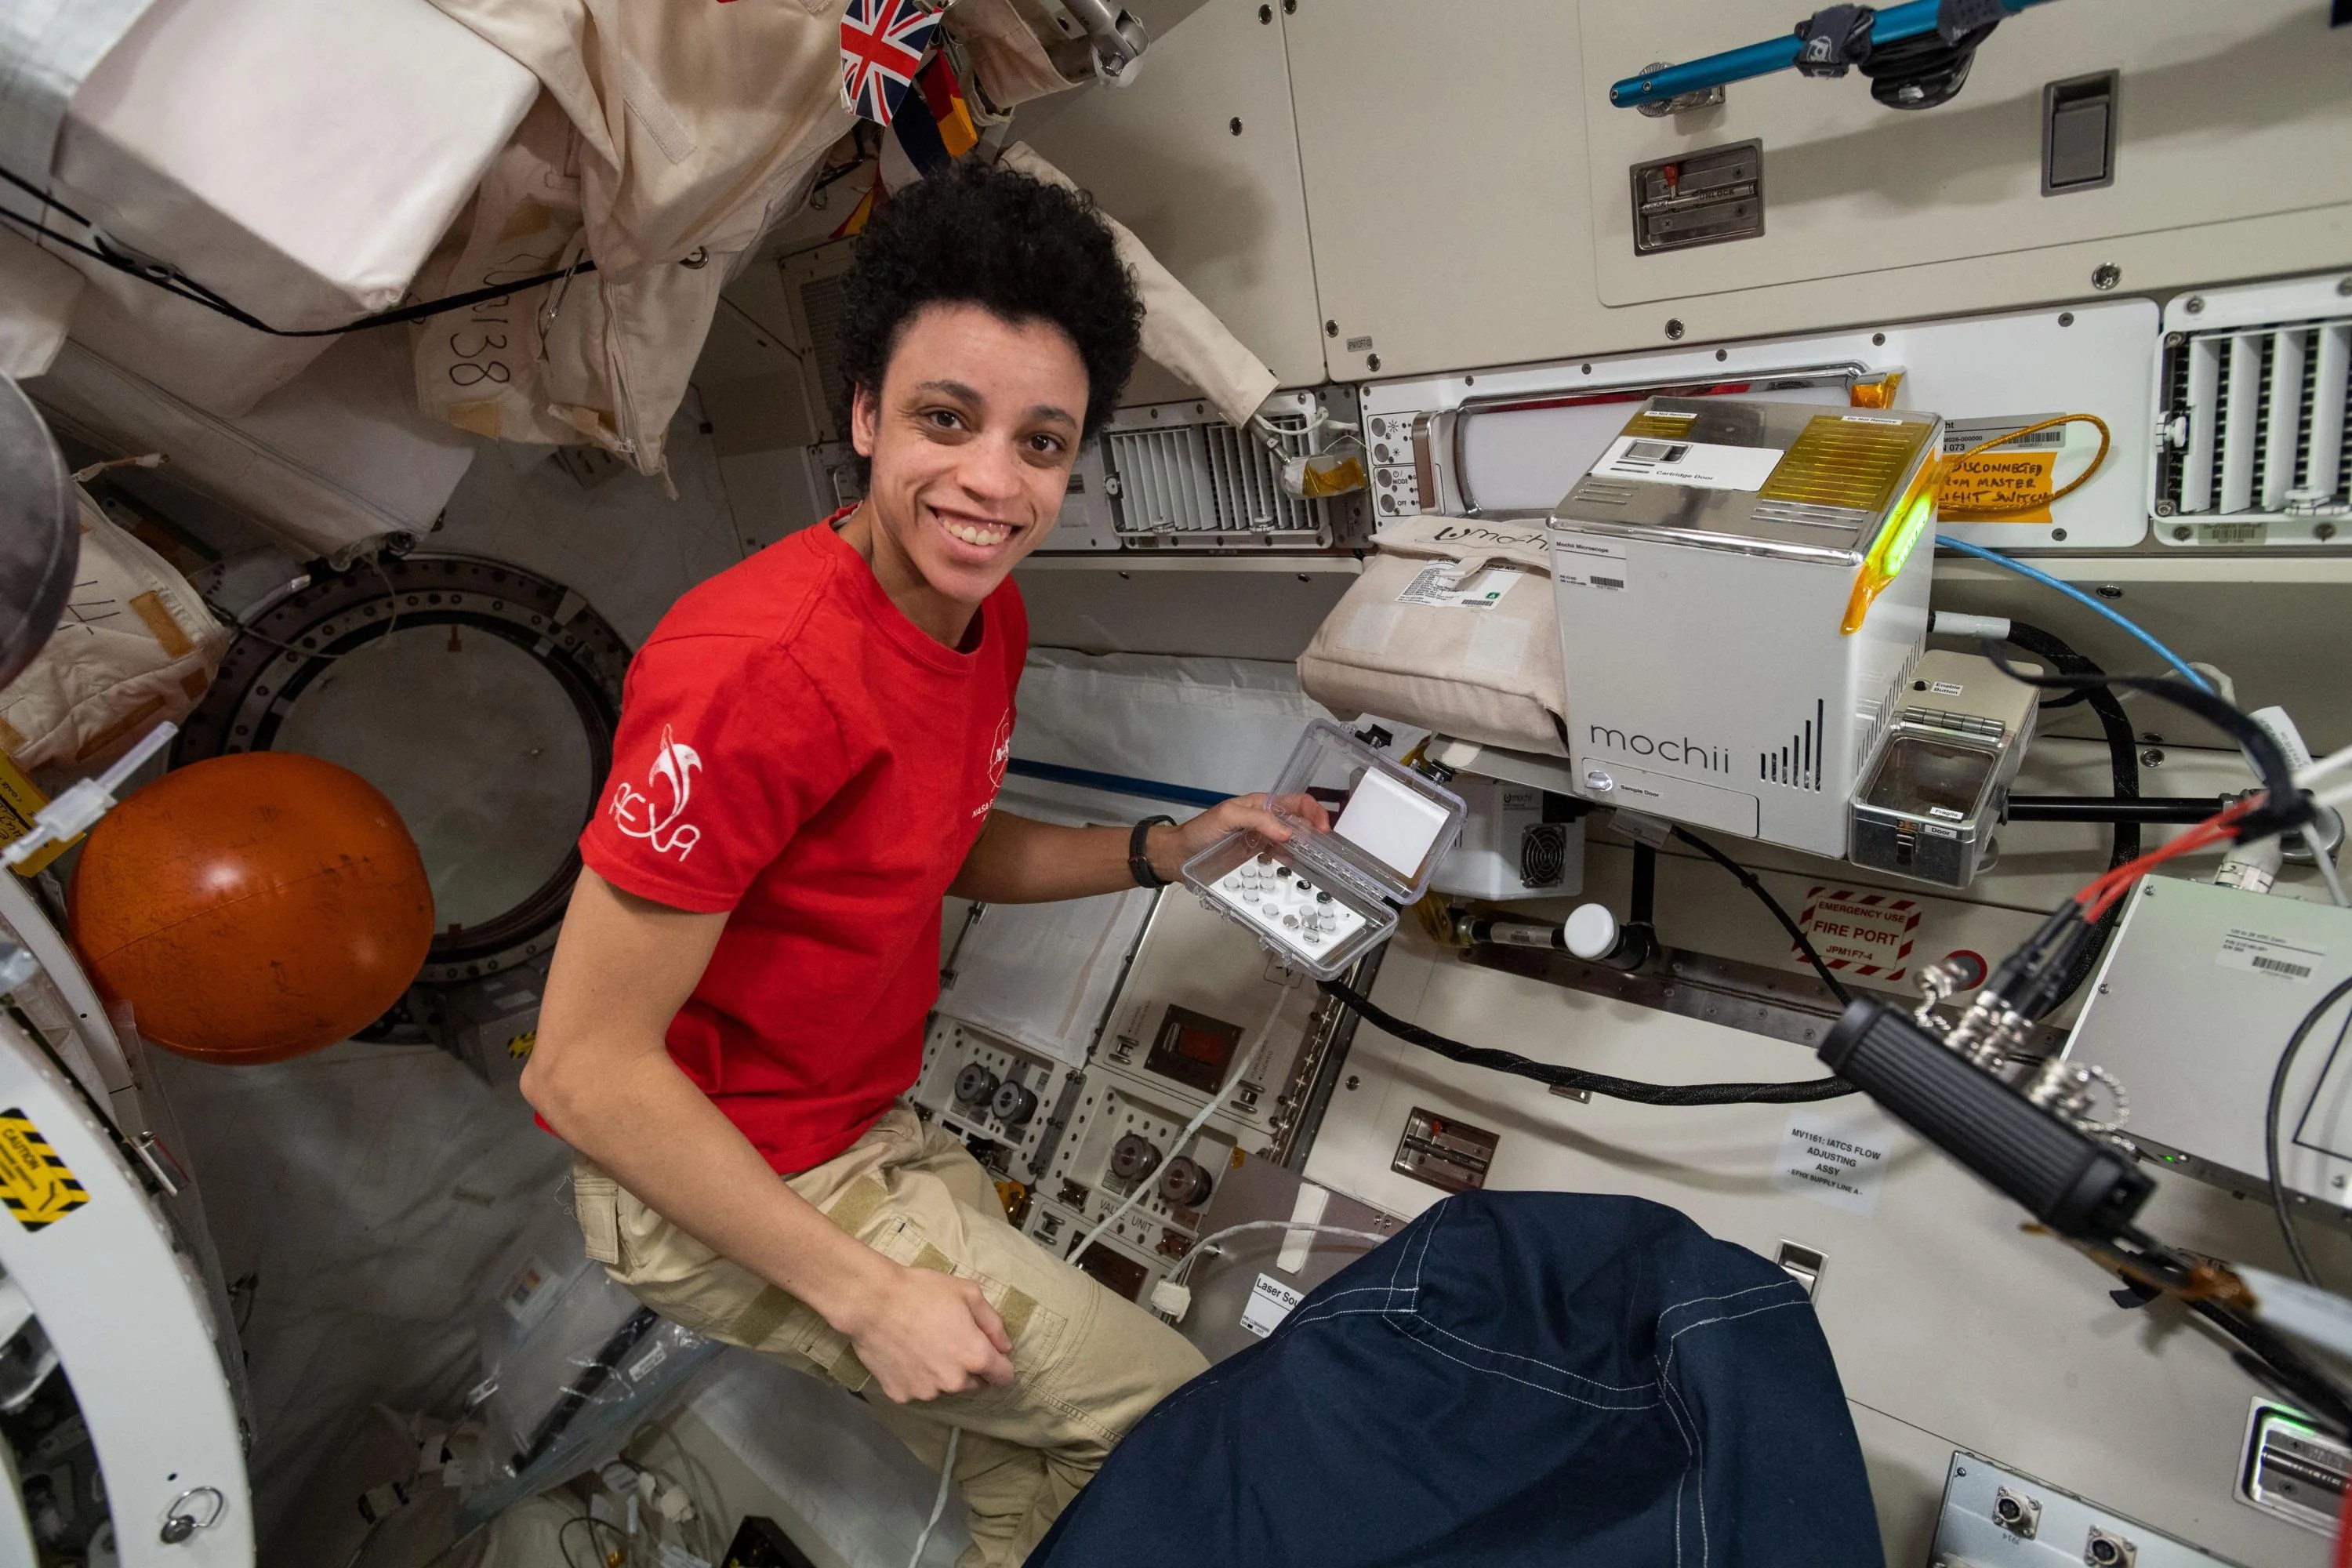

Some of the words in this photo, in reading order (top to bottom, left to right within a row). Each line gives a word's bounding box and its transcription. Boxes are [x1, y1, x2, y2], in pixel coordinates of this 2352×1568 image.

[1698, 187, 1735, 201] UNLOCK
[1656, 470, 1693, 479] Cartridge
[1951, 462, 2043, 477] DISCONNECTED
[1945, 477, 1970, 488] ROM
[1976, 477, 2036, 489] MASTER
[1576, 543, 1610, 554] Microscope
[1590, 724, 1730, 774] mochii
[1620, 784, 1643, 794] Sample
[1644, 788, 1661, 797] Door
[972, 802, 989, 818] NASA
[1934, 809, 1958, 818] Fragile
[1931, 827, 1951, 836] Door
[1818, 902, 1882, 919] EMERGENCY
[1884, 912, 1906, 924] USE
[1813, 920, 1849, 938] FIRE
[1853, 927, 1899, 946] PORT
[1826, 945, 1873, 960] JPM1F7-4
[3, 1128, 40, 1170] CAUTION
[1806, 1146, 1857, 1167] ADJUSTING
[1827, 1138, 1853, 1152] IATCS
[1854, 1146, 1882, 1160] FLOW
[1816, 1163, 1841, 1177] ASSY
[1791, 1169, 1809, 1180] EFHX
[1809, 1174, 1836, 1188] SUPPLY
[1837, 1182, 1853, 1193] LINE
[1100, 1199, 1128, 1221] VALE
[1131, 1216, 1154, 1233] UNIT
[1256, 1278, 1282, 1298] Laser
